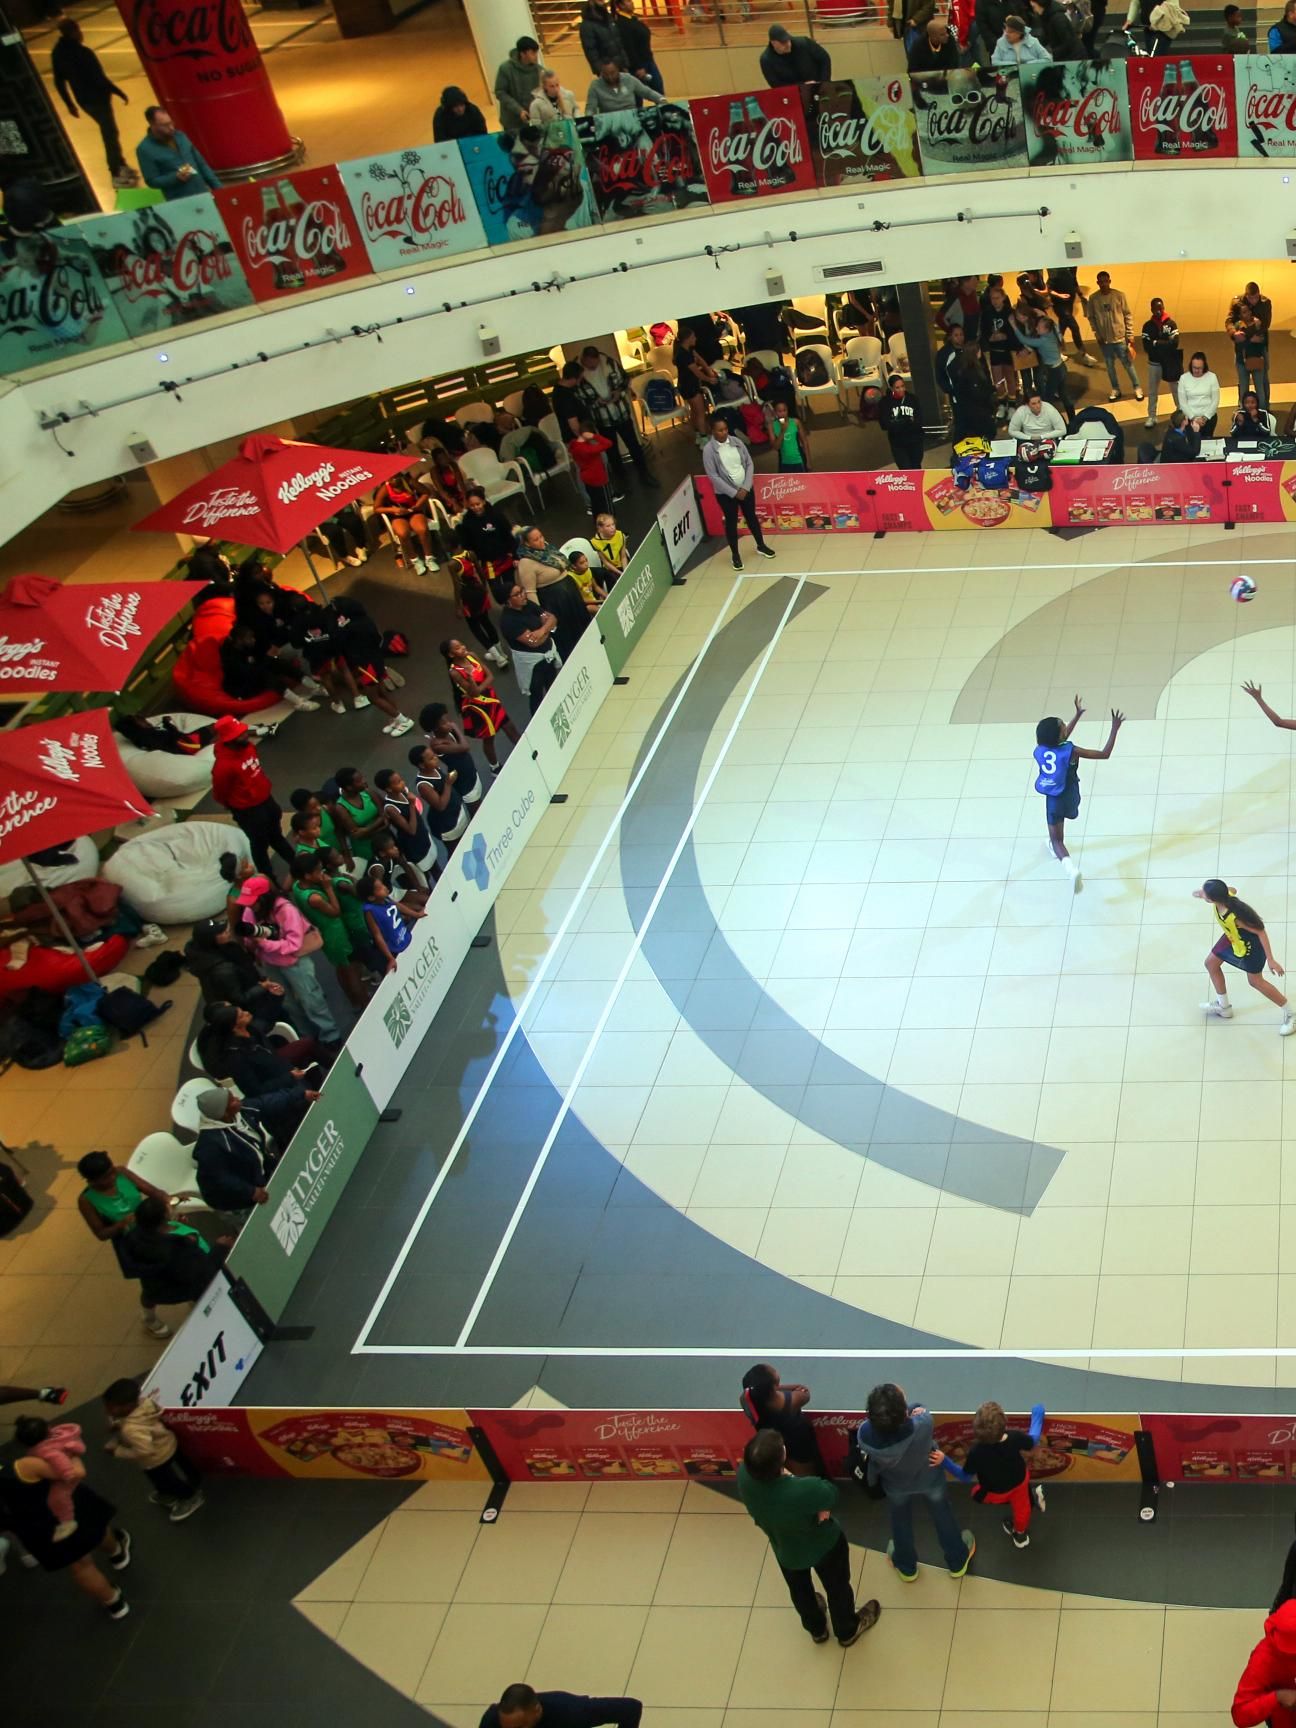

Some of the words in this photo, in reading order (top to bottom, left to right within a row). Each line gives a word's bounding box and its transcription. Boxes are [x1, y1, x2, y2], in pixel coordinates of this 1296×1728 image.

[1033, 87, 1121, 138] Coca-Cola
[1139, 83, 1228, 133] Coca-Cola
[818, 104, 913, 159] Coca-Cola
[708, 117, 803, 175] Coca-Cola
[1076, 143, 1102, 154] Magic
[1162, 141, 1181, 149] Real
[1182, 140, 1208, 149] Magic
[1267, 139, 1285, 147] Real
[845, 165, 865, 175] Real
[865, 162, 891, 172] Magic
[737, 180, 757, 190] Real
[759, 176, 785, 187] Magic
[362, 175, 466, 243] Coca-Cola
[242, 200, 352, 268] Coca-Cola
[399, 245, 421, 257] Real
[422, 239, 449, 252] Magic
[282, 270, 304, 283] Real
[305, 264, 336, 278] Magic
[0, 264, 104, 334] a-Cola
[875, 474, 908, 484] Kellogg's
[1122, 467, 1140, 481] Taste
[1233, 465, 1265, 475] Kellogg's
[278, 462, 335, 504] Kellogg's
[315, 470, 373, 501] Noodles
[761, 484, 807, 501] Difference
[767, 476, 785, 490] Taste
[888, 484, 916, 492] Noodles
[1113, 475, 1160, 491] Difference
[209, 487, 239, 508] Taste
[238, 490, 257, 506] the
[1253, 504, 1258, 512] 3
[183, 502, 260, 527] Difference
[673, 510, 691, 547] EXIT
[603, 544, 614, 560] 1
[628, 564, 653, 606] TYGER
[0, 666, 58, 680] oodles
[562, 666, 590, 714] TYGER
[1042, 751, 1057, 774] 3
[5, 790, 38, 815] the
[487, 827, 513, 869] Three
[512, 790, 535, 828] Cube
[387, 905, 402, 929] 2
[402, 936, 440, 1001] TYGER
[292, 1120, 339, 1200] TYGER
[181, 1331, 226, 1407] EXIT
[607, 1413, 639, 1427] Taste
[647, 1414, 669, 1425] the
[595, 1422, 680, 1441] Difference
